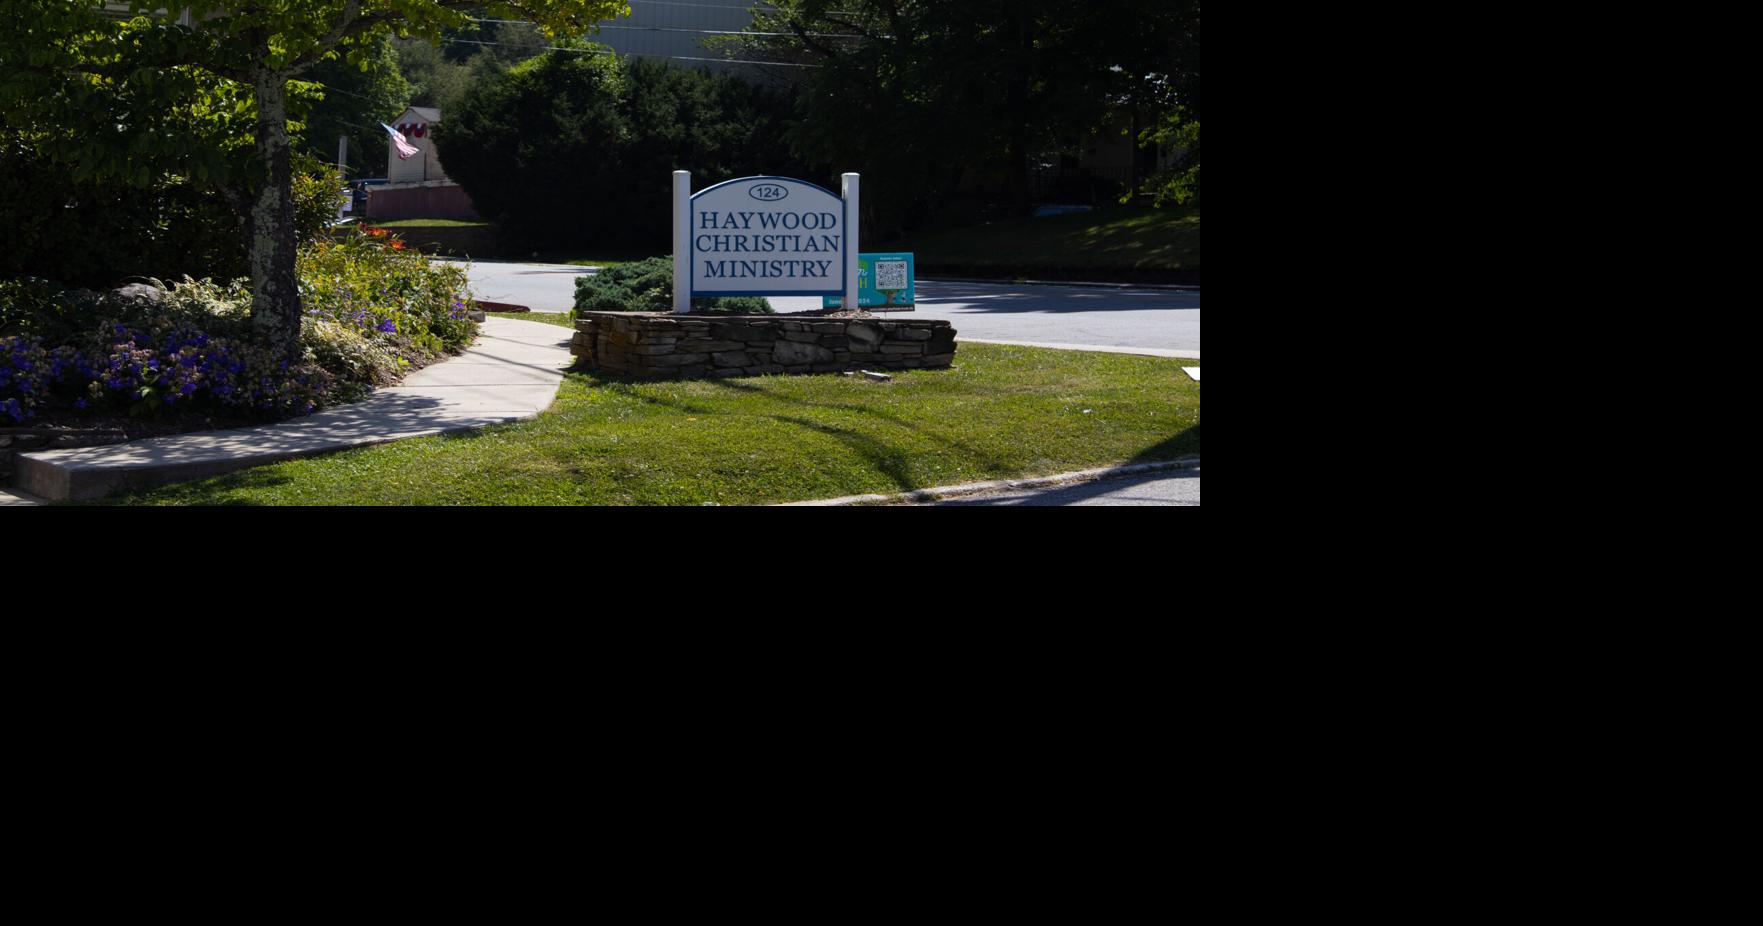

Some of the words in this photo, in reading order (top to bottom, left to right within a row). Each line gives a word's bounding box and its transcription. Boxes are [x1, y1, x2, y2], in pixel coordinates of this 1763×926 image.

[757, 187, 780, 198] 124
[700, 211, 837, 230] HAYWOOD
[695, 234, 841, 253] CHRISTIAN
[704, 260, 833, 278] MINISTRY
